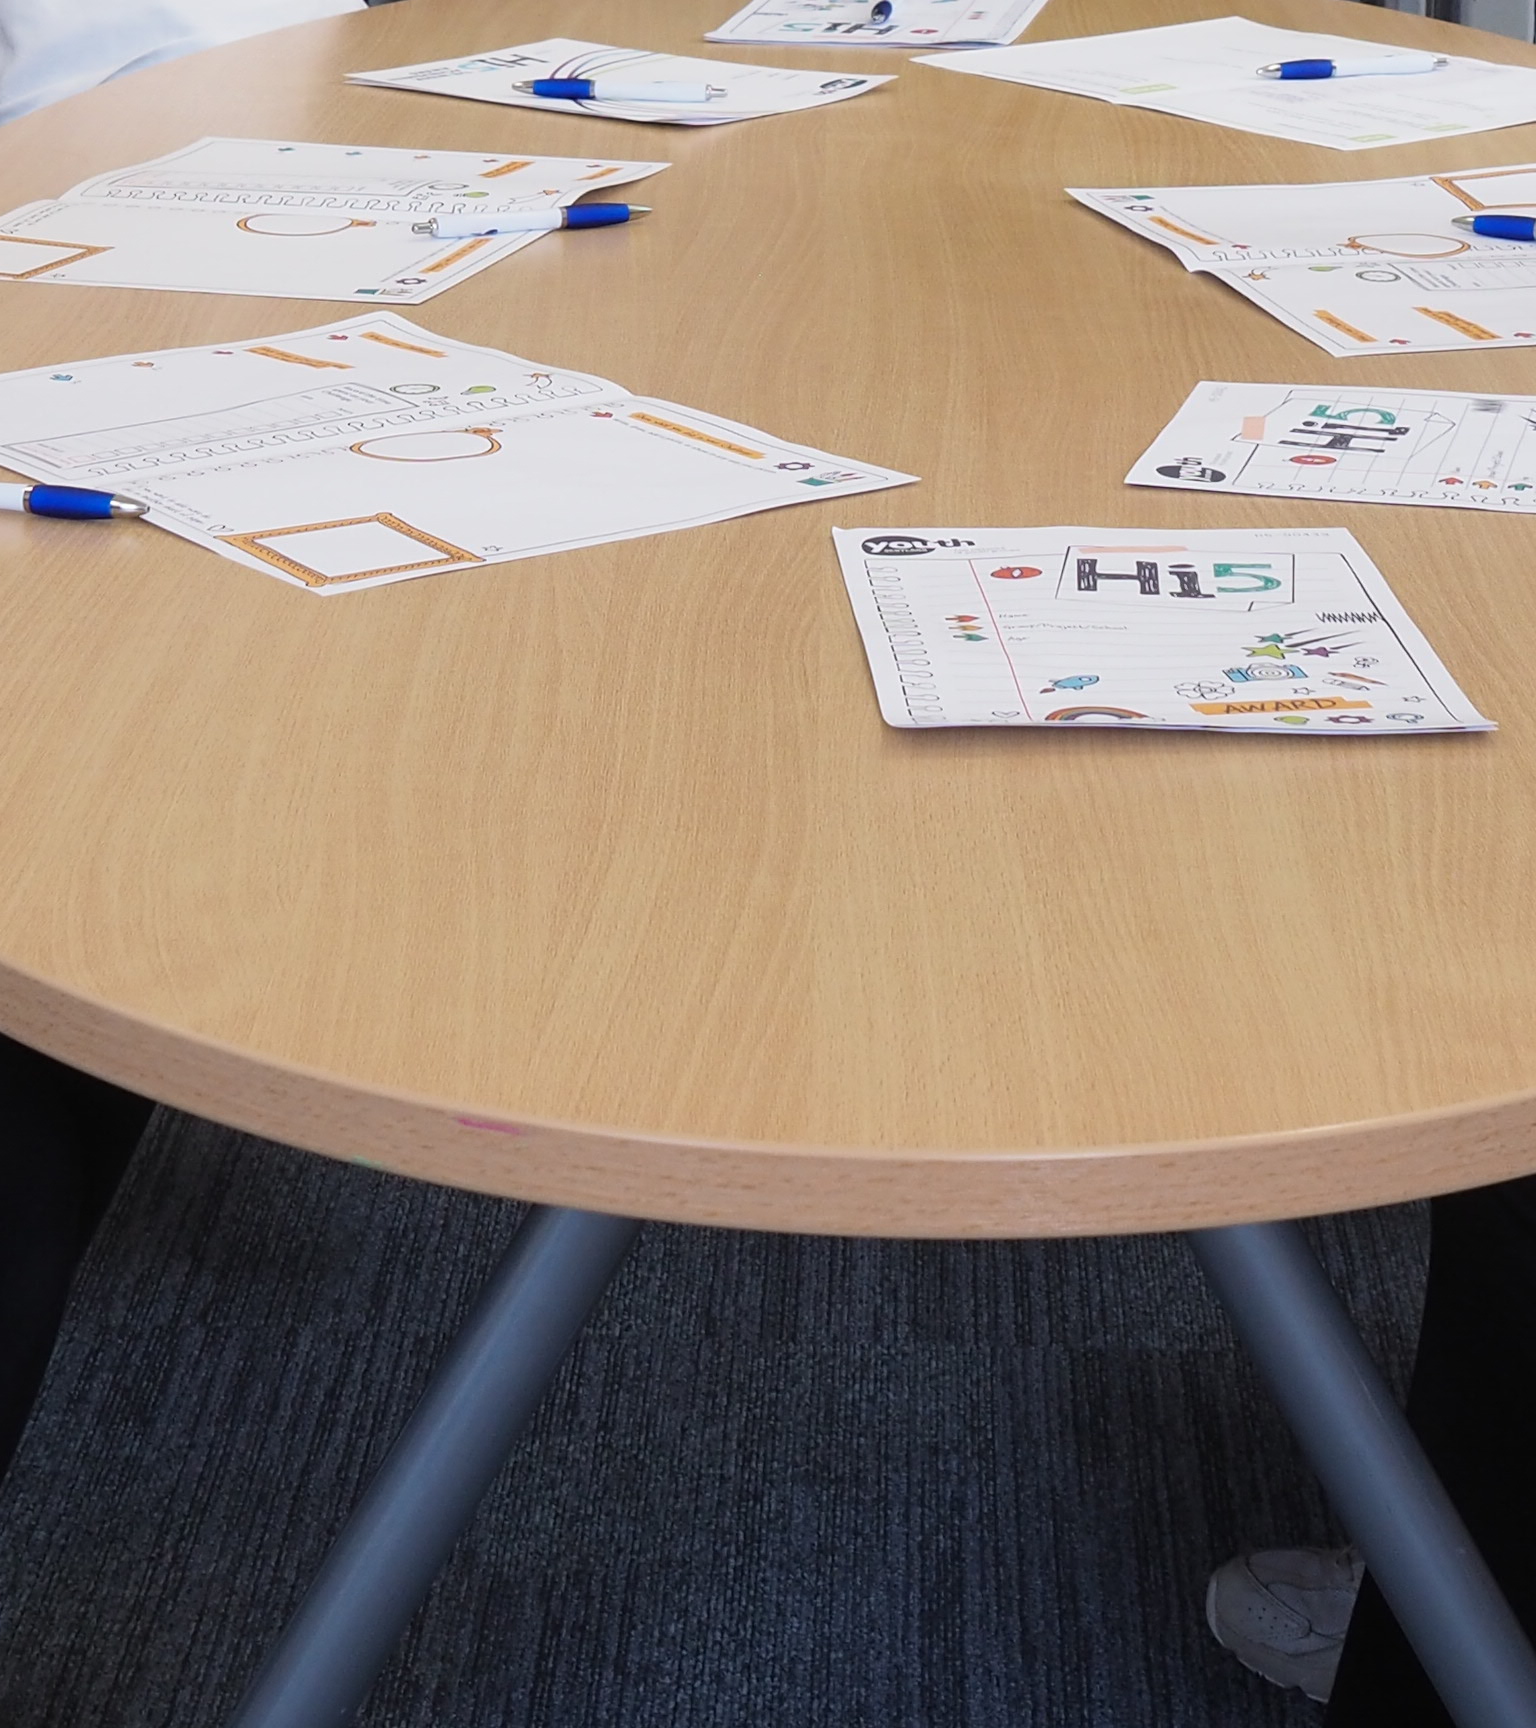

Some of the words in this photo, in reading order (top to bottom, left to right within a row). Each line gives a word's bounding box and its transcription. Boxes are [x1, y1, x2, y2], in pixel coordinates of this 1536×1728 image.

[1278, 403, 1411, 453] Hi5
[865, 538, 976, 554] youth
[1076, 558, 1282, 599] Hi5
[1223, 697, 1338, 715] AWARD
